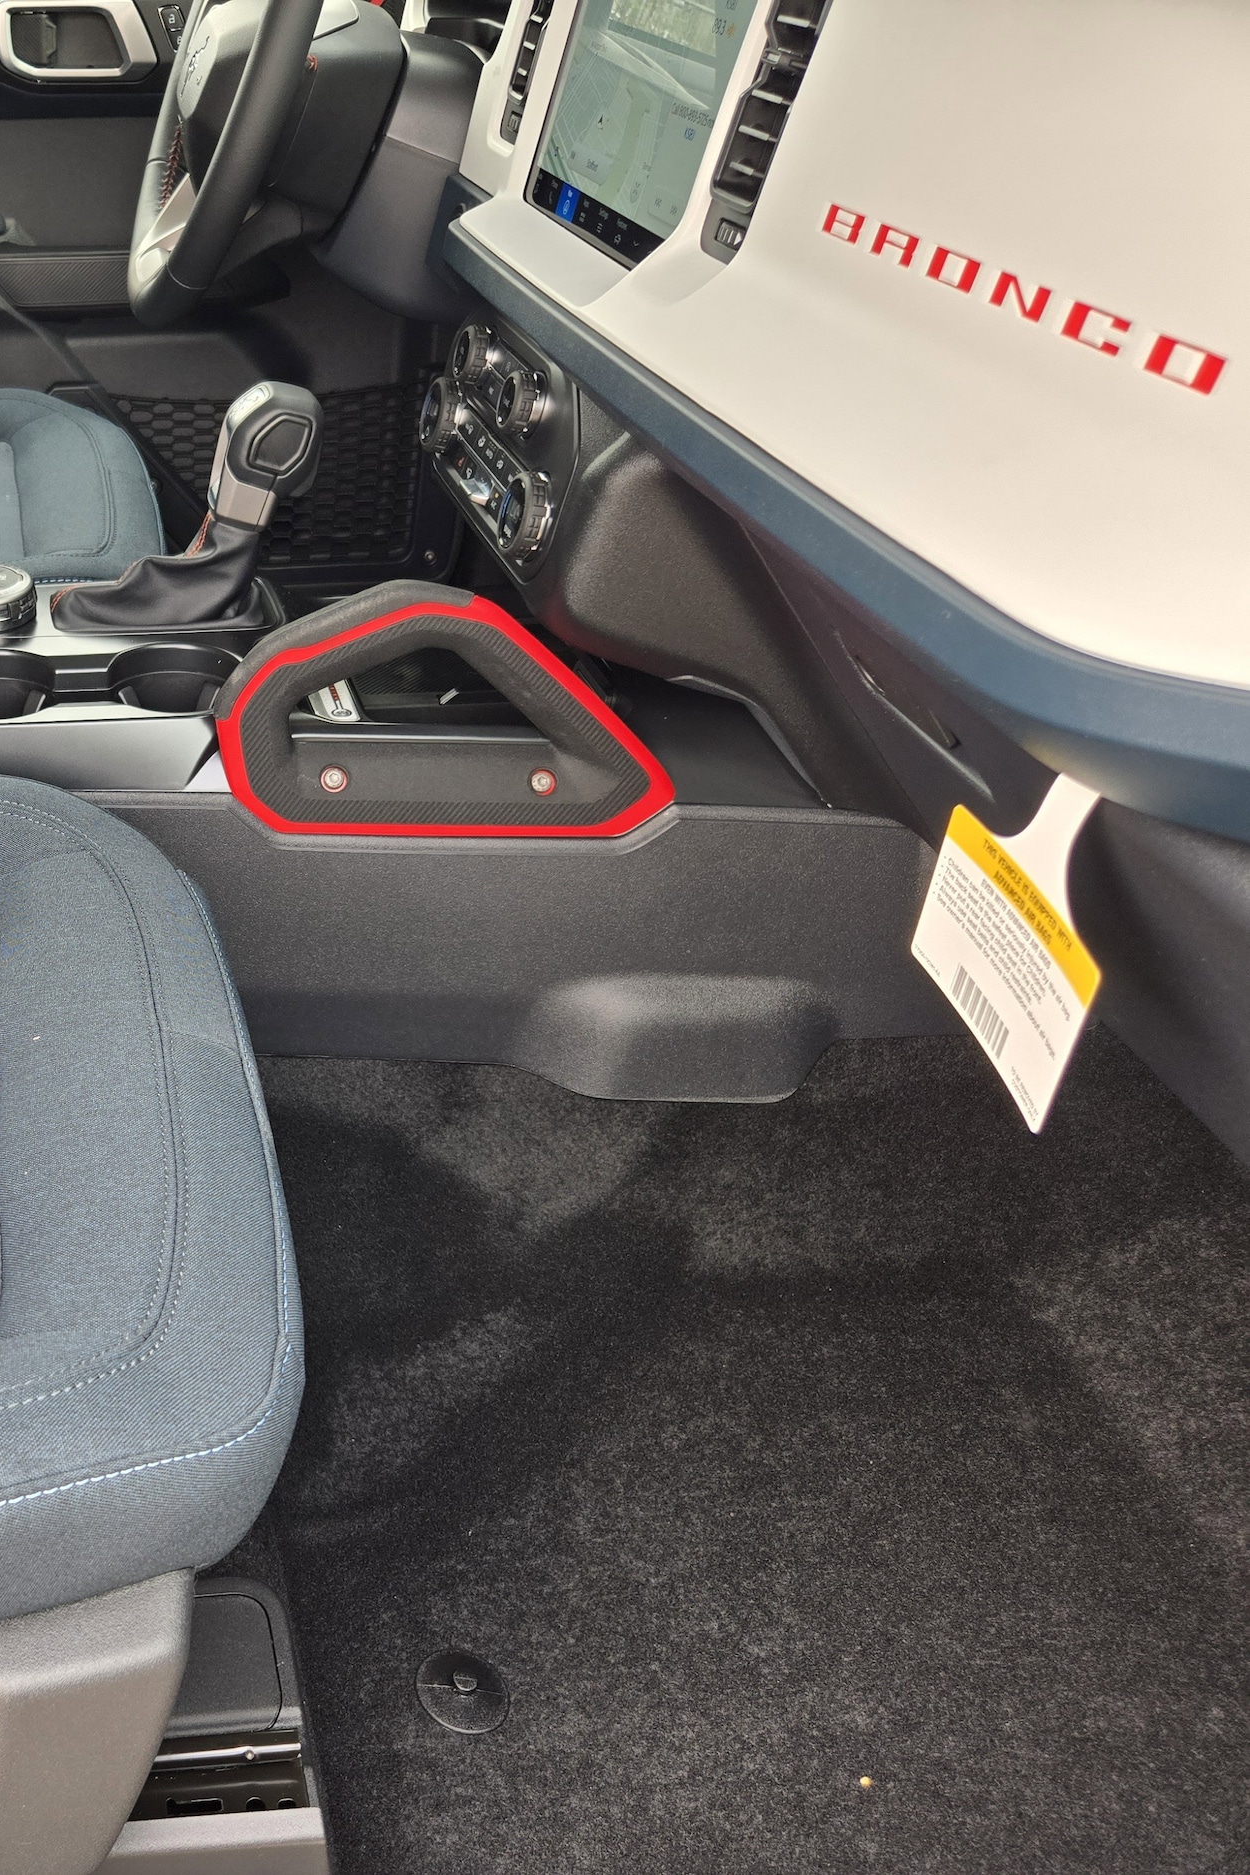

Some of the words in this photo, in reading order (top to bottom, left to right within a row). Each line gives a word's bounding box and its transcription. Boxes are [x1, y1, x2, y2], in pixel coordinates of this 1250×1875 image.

[822, 203, 1227, 395] BRONCO
[982, 839, 997, 860] THIS
[997, 855, 1022, 888] VEHICLE
[1021, 882, 1029, 896] IS
[1028, 890, 1056, 931] EQUIPPED
[1056, 926, 1072, 952] WITH
[993, 868, 1025, 912] ADVANCED
[1024, 905, 1036, 926] AIR
[1034, 919, 1051, 946] BAGS
